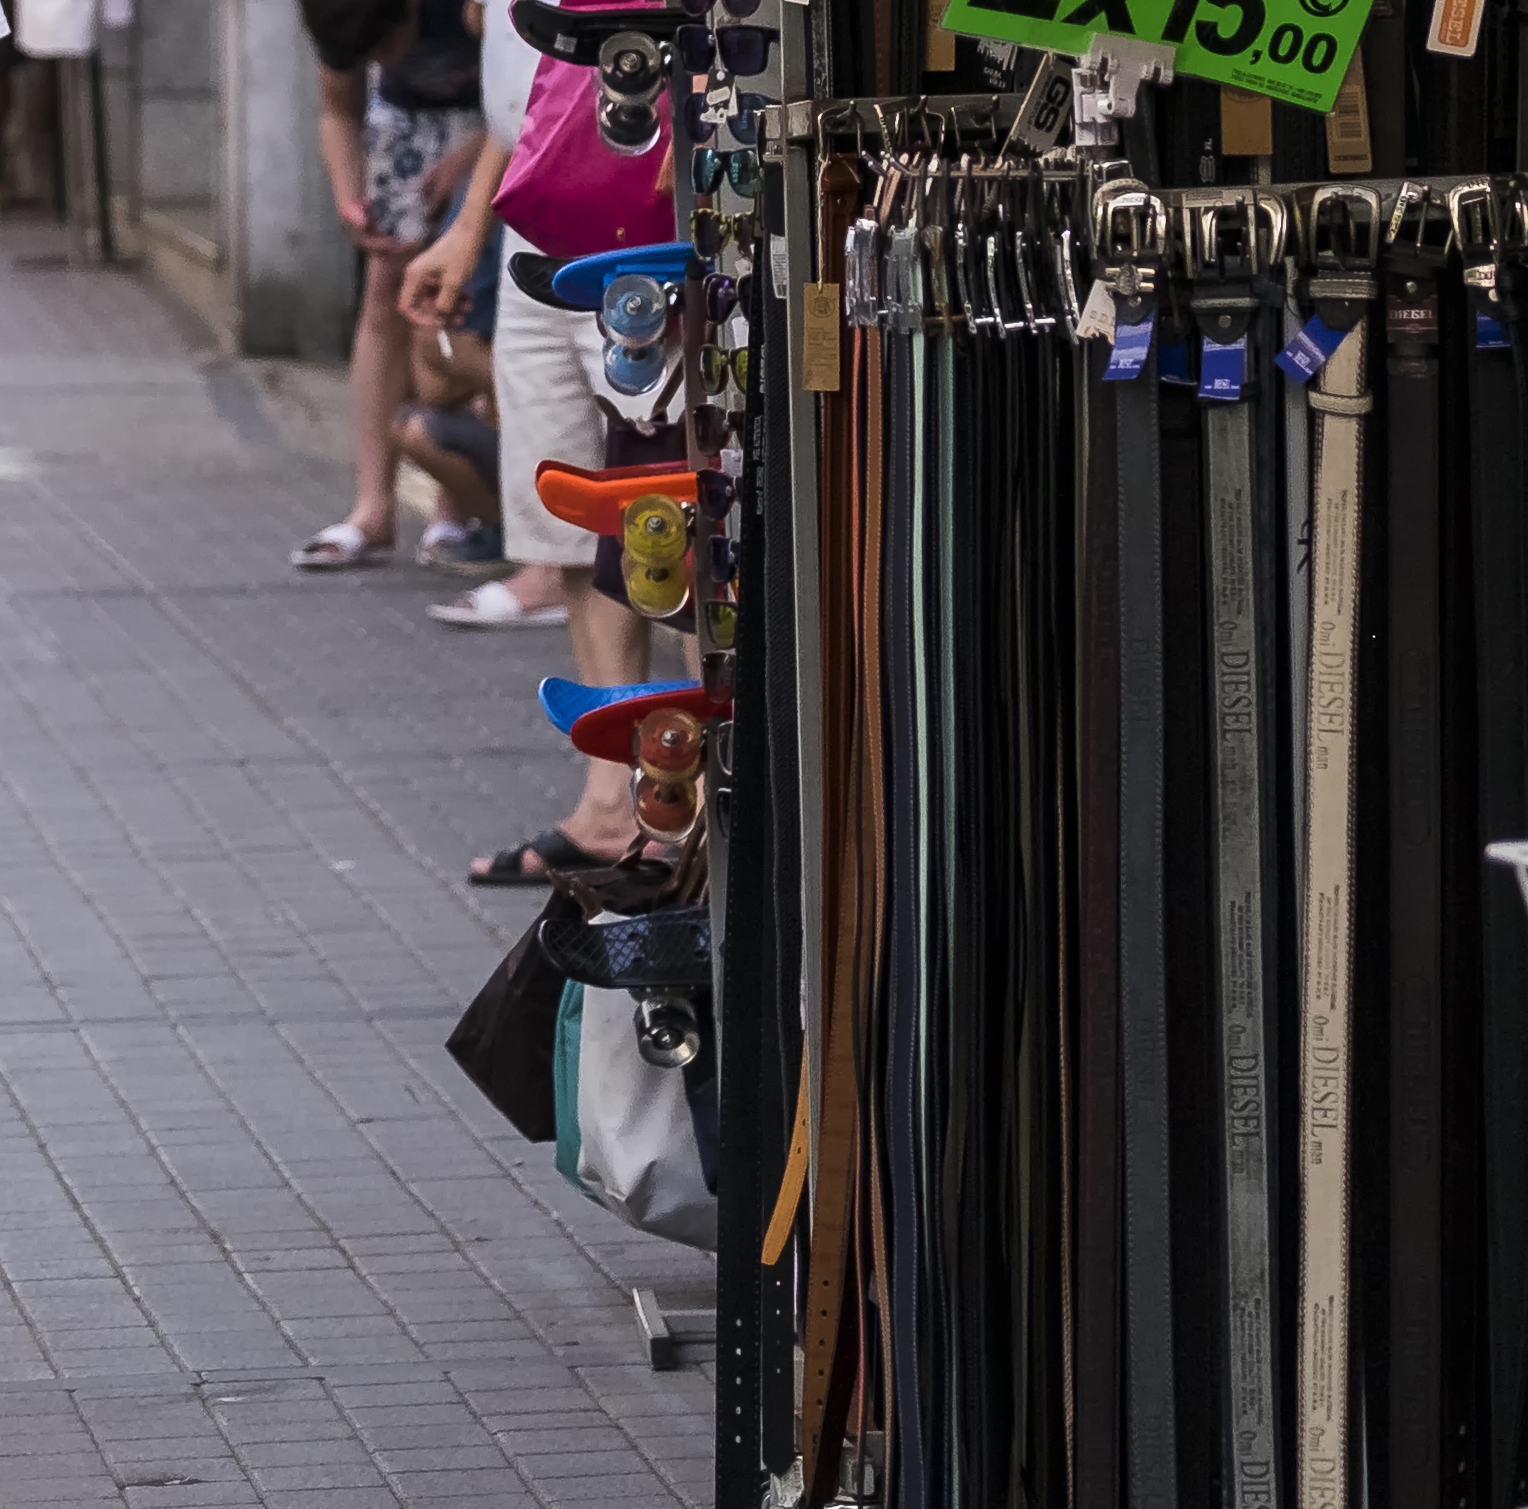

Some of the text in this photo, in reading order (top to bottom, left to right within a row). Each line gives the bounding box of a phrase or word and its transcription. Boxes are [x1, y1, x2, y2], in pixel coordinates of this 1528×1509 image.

[1222, 650, 1252, 742] DIESEL
[1317, 651, 1345, 741] DIESEL
[1230, 1052, 1261, 1150] DIESEL
[1311, 1046, 1340, 1137] DIESEL
